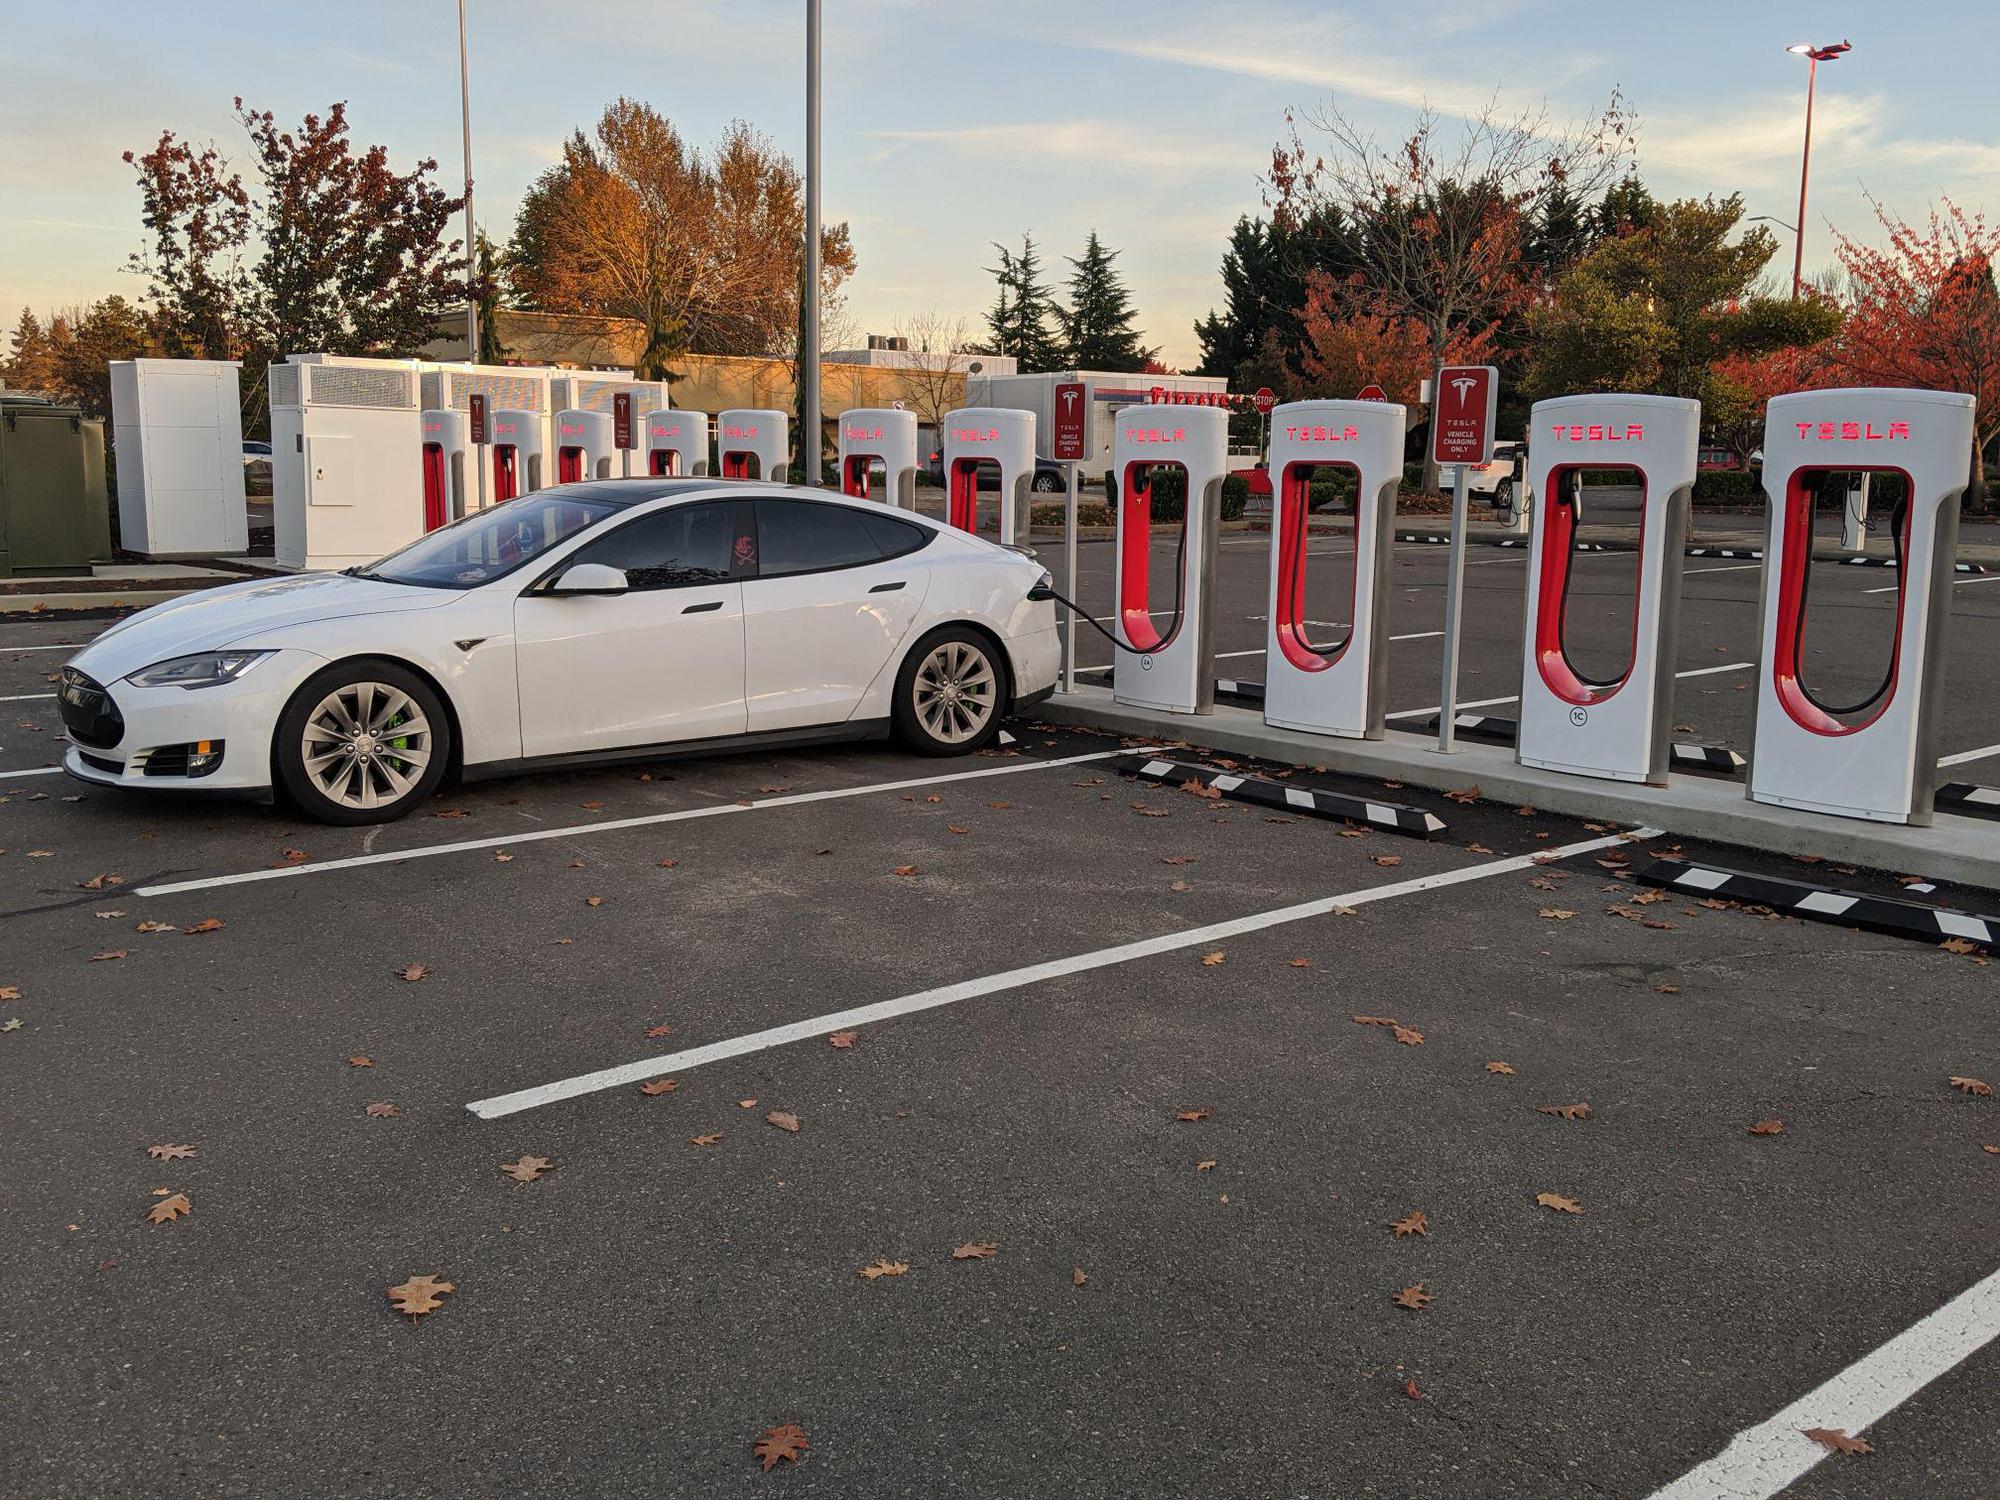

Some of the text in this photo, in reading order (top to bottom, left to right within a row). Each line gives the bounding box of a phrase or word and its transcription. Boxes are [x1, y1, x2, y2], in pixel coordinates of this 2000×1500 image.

[1256, 396, 1274, 405] STOP
[1447, 419, 1477, 427] TESLA
[845, 427, 884, 440] TESLA
[952, 428, 999, 441] TESLA
[1126, 429, 1185, 442] TESLA
[1285, 426, 1359, 441] TESLA
[1552, 424, 1643, 441] TESLA
[1795, 421, 1911, 440] TESLA
[1443, 438, 1477, 446] CHARGING
[1573, 712, 1584, 720] 1C
